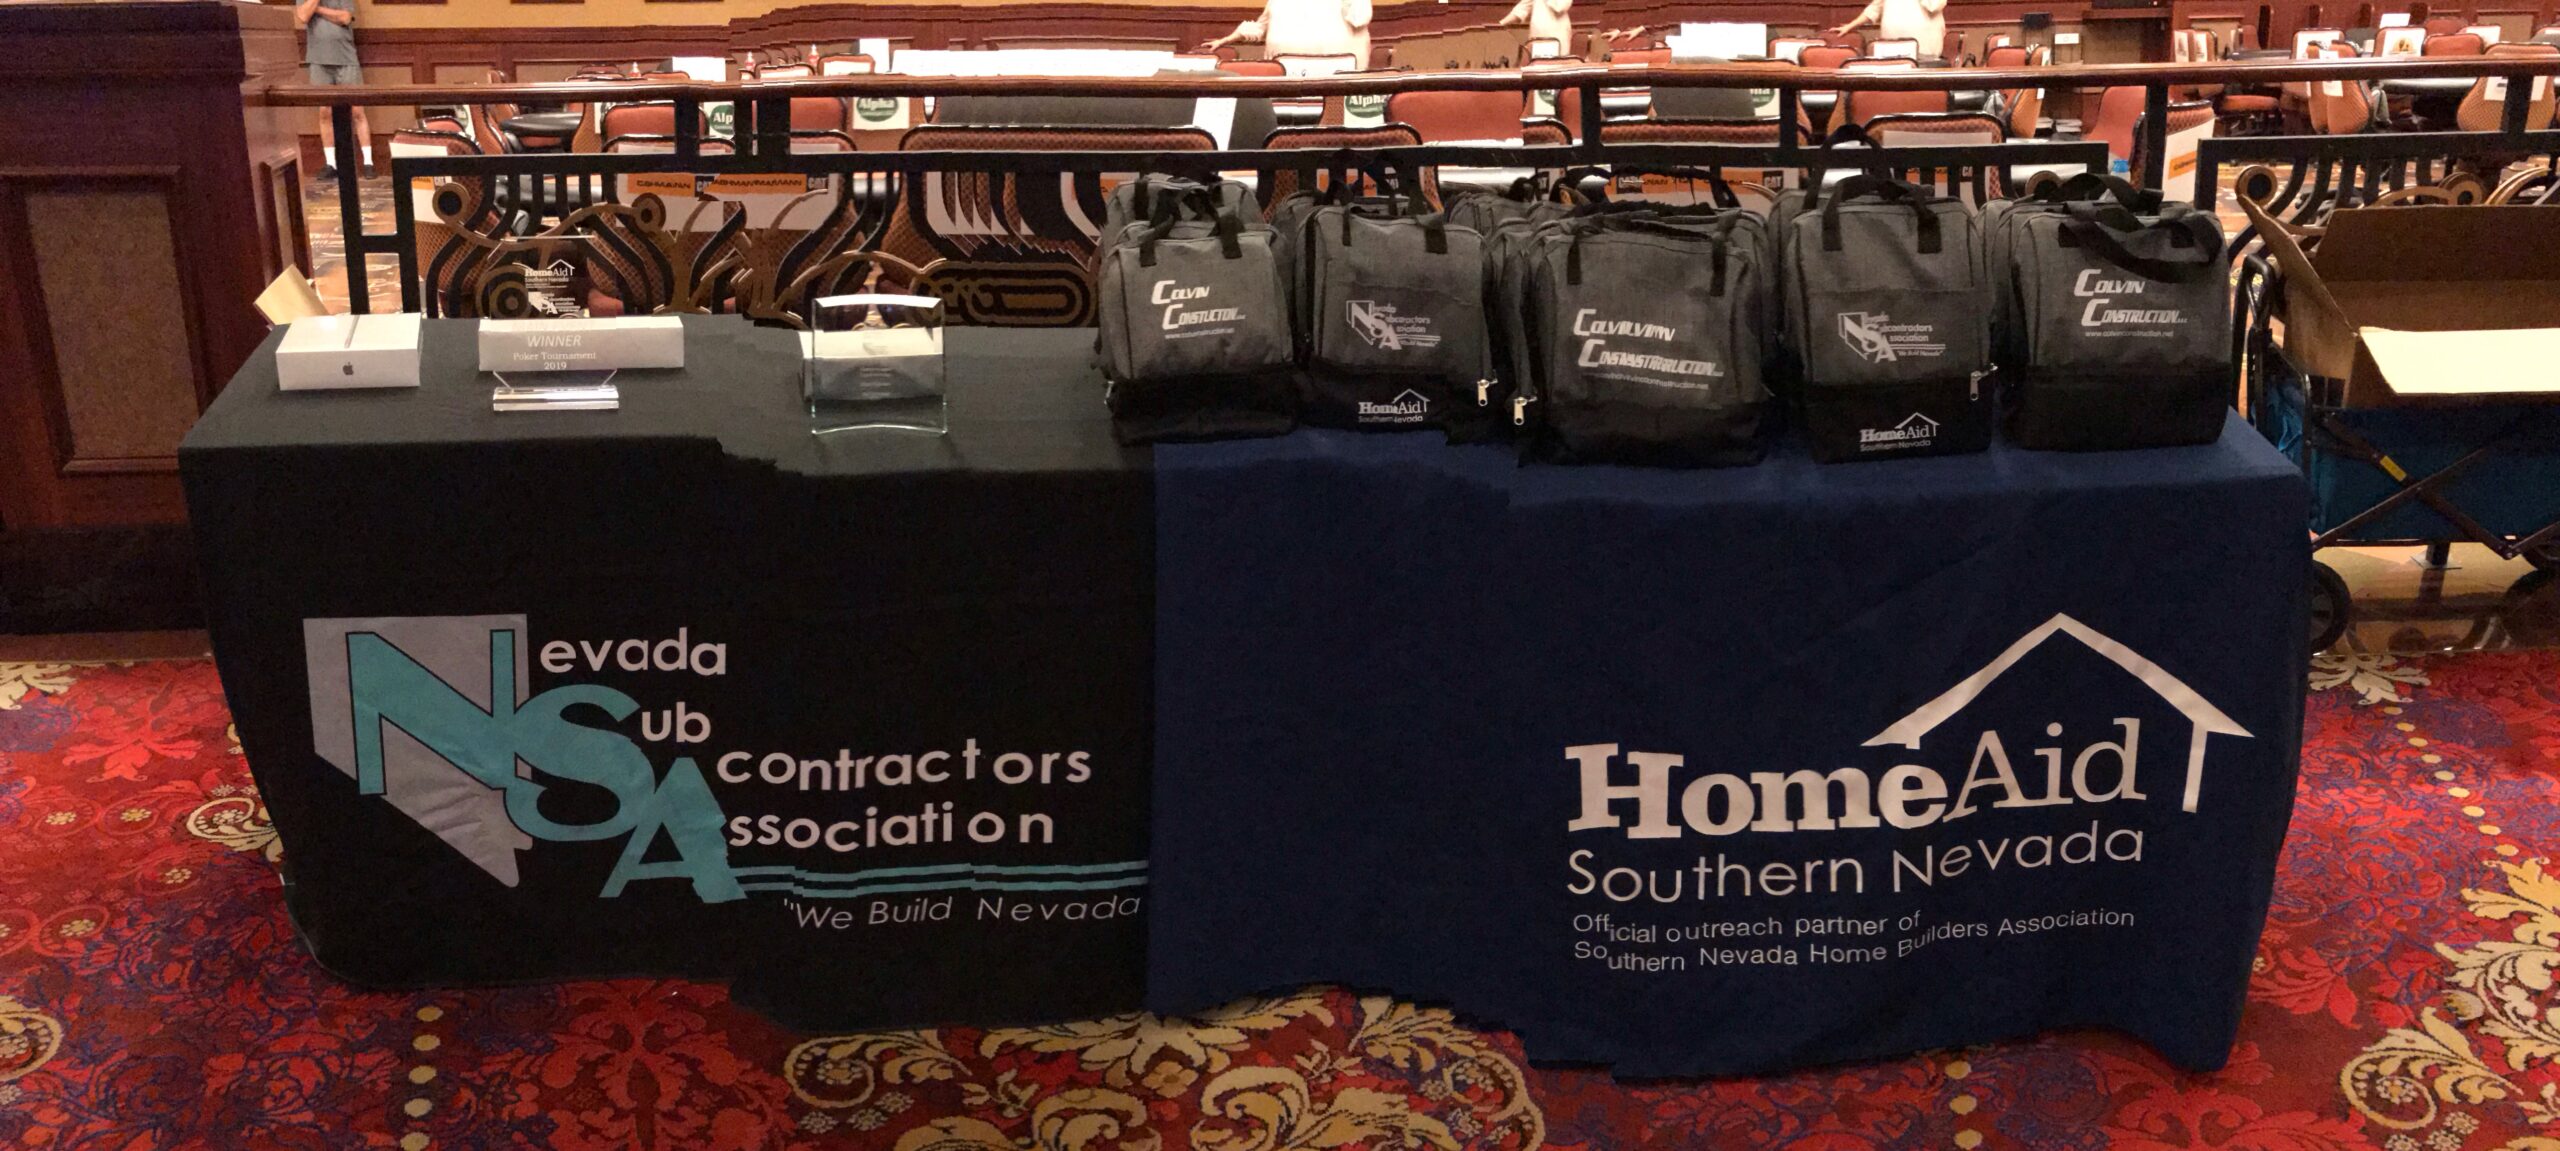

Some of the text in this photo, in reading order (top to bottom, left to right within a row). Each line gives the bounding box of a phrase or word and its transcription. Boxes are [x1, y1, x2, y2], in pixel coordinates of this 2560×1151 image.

[1151, 279, 1210, 305] COLVIN
[2074, 268, 2146, 297] COLVIN
[2081, 298, 2180, 327] CONSTRUCTION
[513, 351, 597, 361] Poker Tournament
[527, 335, 582, 348] WINNER
[543, 362, 567, 370] 2019
[717, 738, 1092, 791] contractors
[1565, 717, 2147, 839] HomeAid
[1567, 820, 2143, 903] Southern Nevada
[868, 897, 952, 926] Build
[977, 894, 1141, 922] Nevada
[1573, 910, 1921, 943] Official outreach partner of
[1574, 907, 2135, 971] Southern Nevada Home Builders Association
